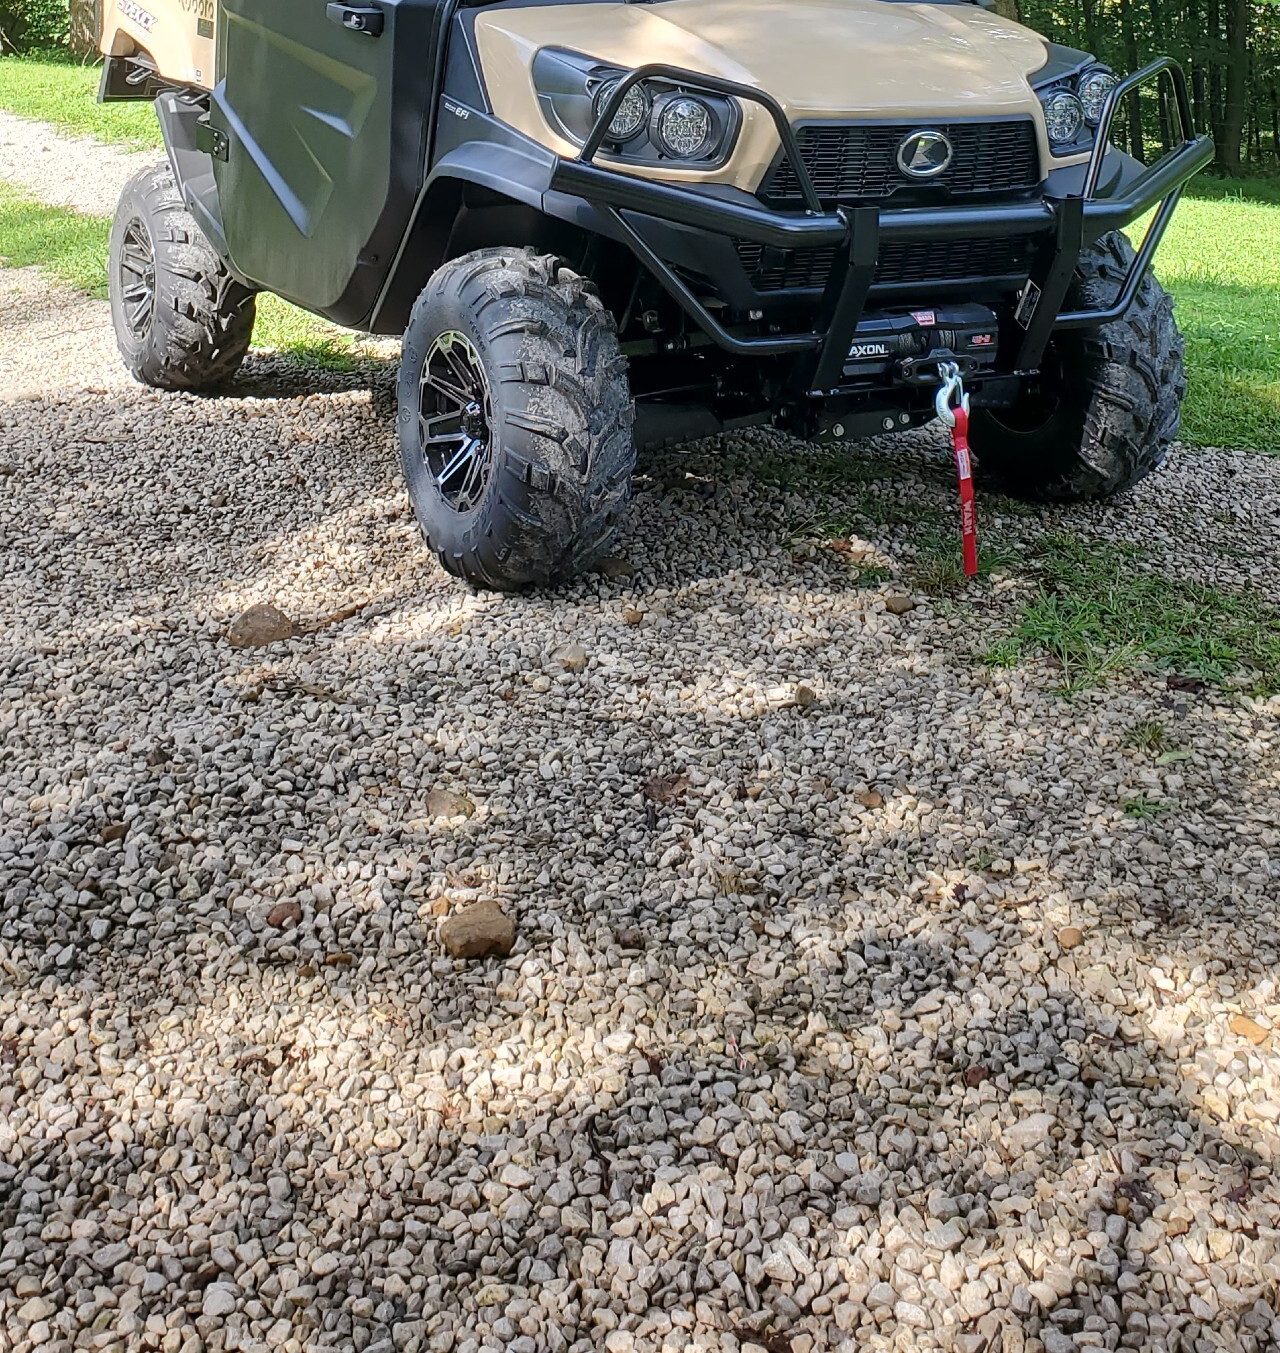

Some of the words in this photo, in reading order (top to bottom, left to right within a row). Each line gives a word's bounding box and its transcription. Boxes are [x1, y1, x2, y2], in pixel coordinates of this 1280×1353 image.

[455, 107, 470, 120] EFI
[848, 343, 886, 358] AXON
[962, 499, 973, 536] WARN
